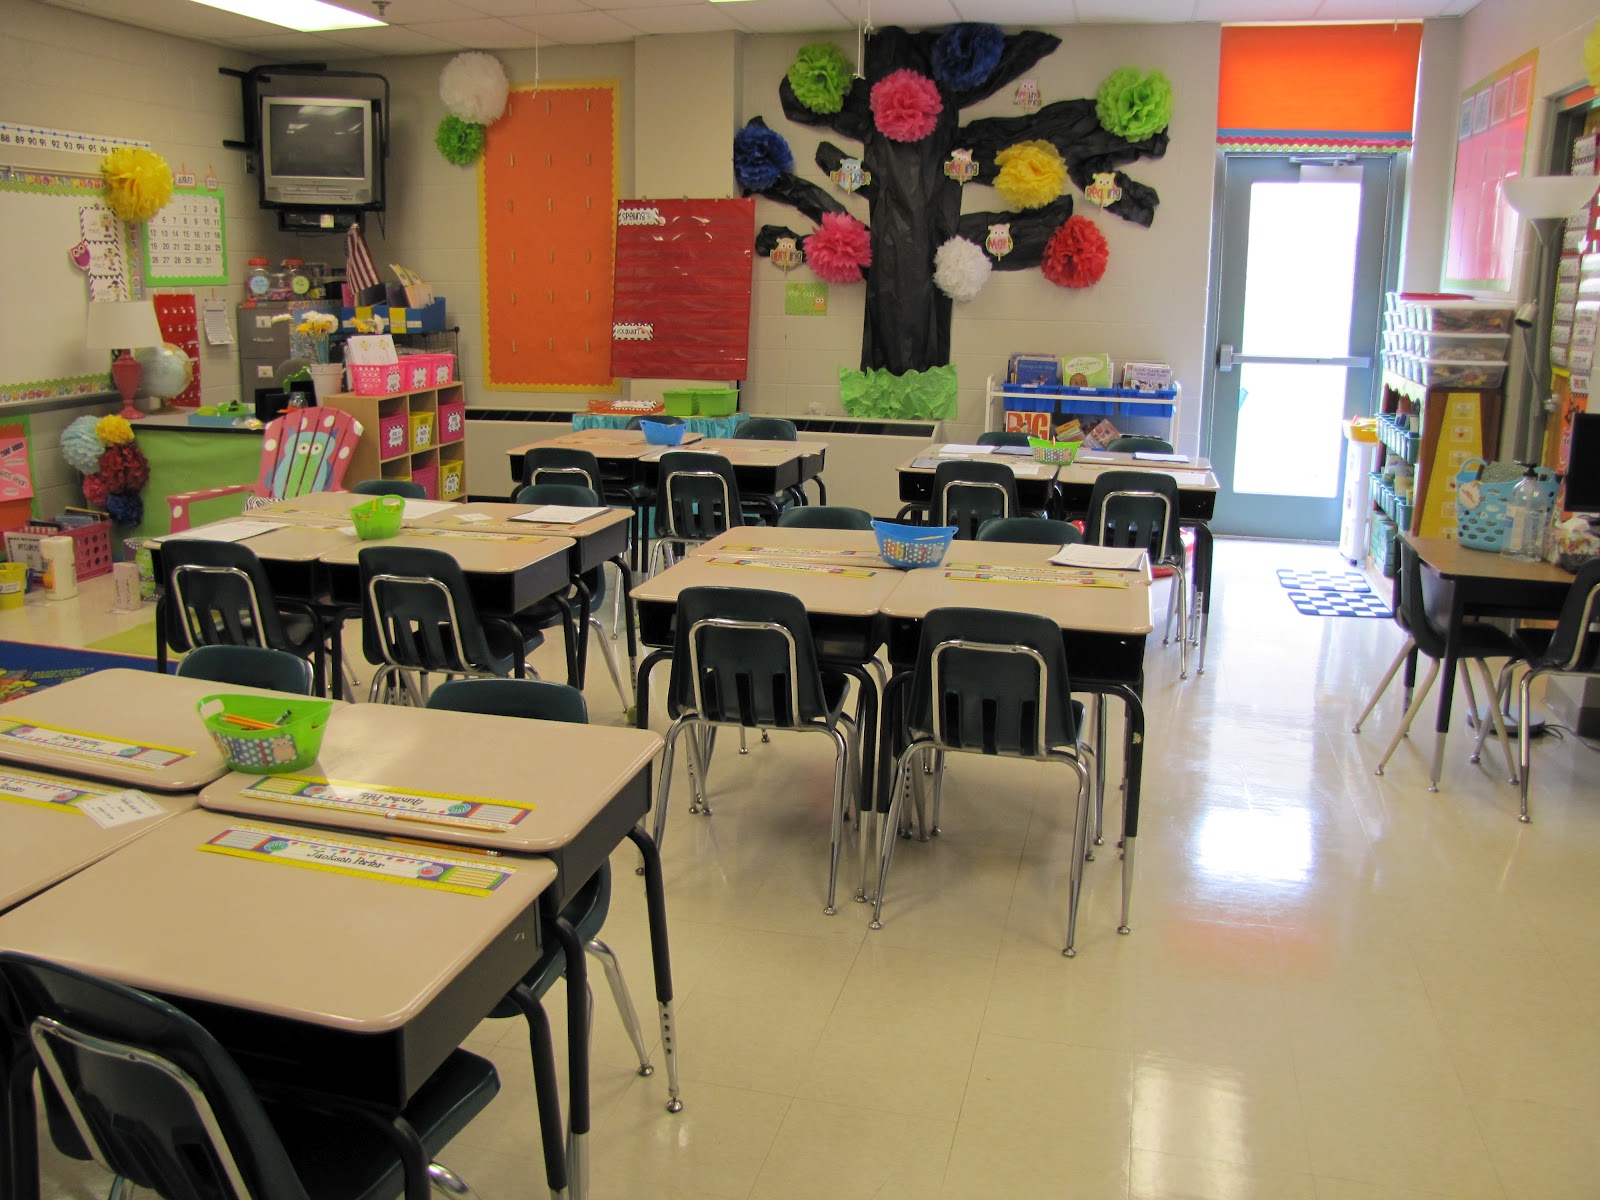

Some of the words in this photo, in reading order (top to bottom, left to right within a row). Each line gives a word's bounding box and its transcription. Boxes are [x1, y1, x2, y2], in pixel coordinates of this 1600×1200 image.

[0, 134, 10, 143] 88
[15, 136, 25, 144] 89
[28, 137, 37, 145] 90
[40, 139, 47, 147] 91
[51, 140, 60, 149] 92
[64, 142, 73, 150] 93
[76, 143, 85, 151] 94
[88, 144, 97, 153] 95
[100, 146, 108, 154] 96
[150, 229, 157, 237] 12
[161, 230, 168, 238] 13
[1008, 413, 1048, 440] BIG
[307, 849, 352, 864] Jackson
[353, 857, 385, 868] Porter
